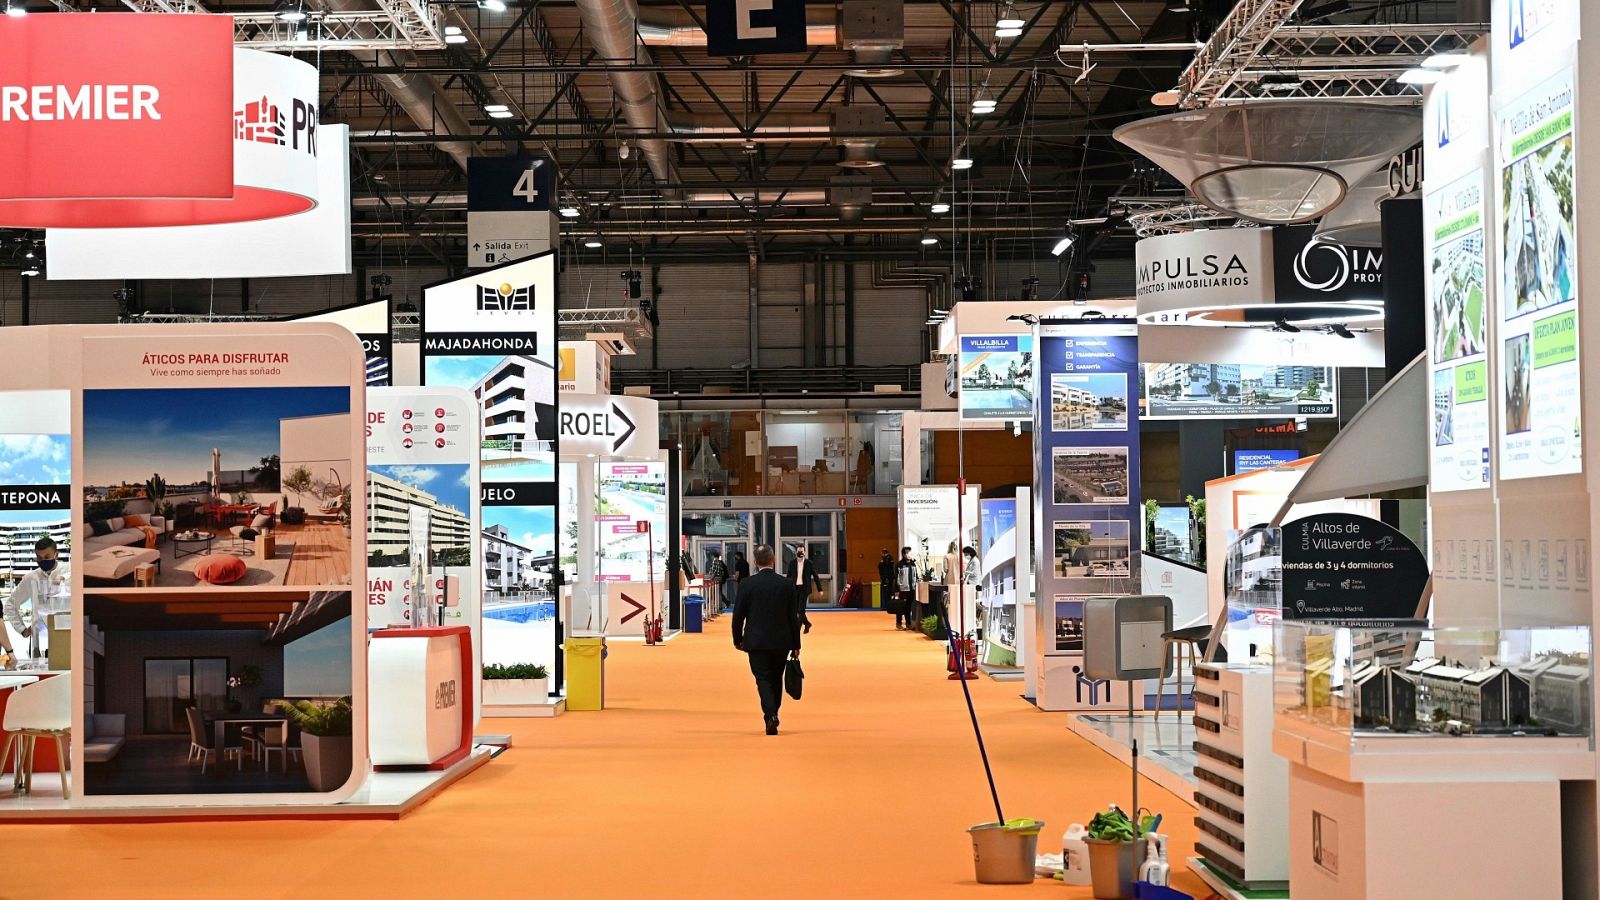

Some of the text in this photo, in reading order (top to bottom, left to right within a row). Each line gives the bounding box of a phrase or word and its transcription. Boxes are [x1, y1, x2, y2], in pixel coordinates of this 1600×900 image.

[292, 97, 316, 158] PR
[512, 169, 538, 203] 4
[485, 242, 529, 250] Salida Exit
[1137, 254, 1248, 285] MPULSA
[1167, 277, 1249, 291] INMOBILIARIOS
[1353, 273, 1382, 283] PROY
[425, 338, 534, 350] MAJADAHONDA
[142, 352, 289, 365] ÁTICOS PARA DISFRUTAR
[150, 368, 168, 376] Vive
[196, 367, 230, 377] siempre
[232, 367, 247, 376] has
[250, 367, 281, 375] soñado
[559, 383, 576, 391] ario
[368, 412, 386, 424] DE
[560, 412, 615, 437] ROEL
[1, 491, 61, 504] TEPONA
[1312, 522, 1360, 533] Altos de
[1312, 538, 1371, 550] Villaverde
[1315, 561, 1325, 569] de
[1326, 561, 1332, 569] 3
[1333, 563, 1339, 571] y
[1340, 561, 1346, 569] 4
[1347, 561, 1394, 569] dormitorios
[368, 577, 393, 592] IÁN
[368, 594, 386, 605] ES
